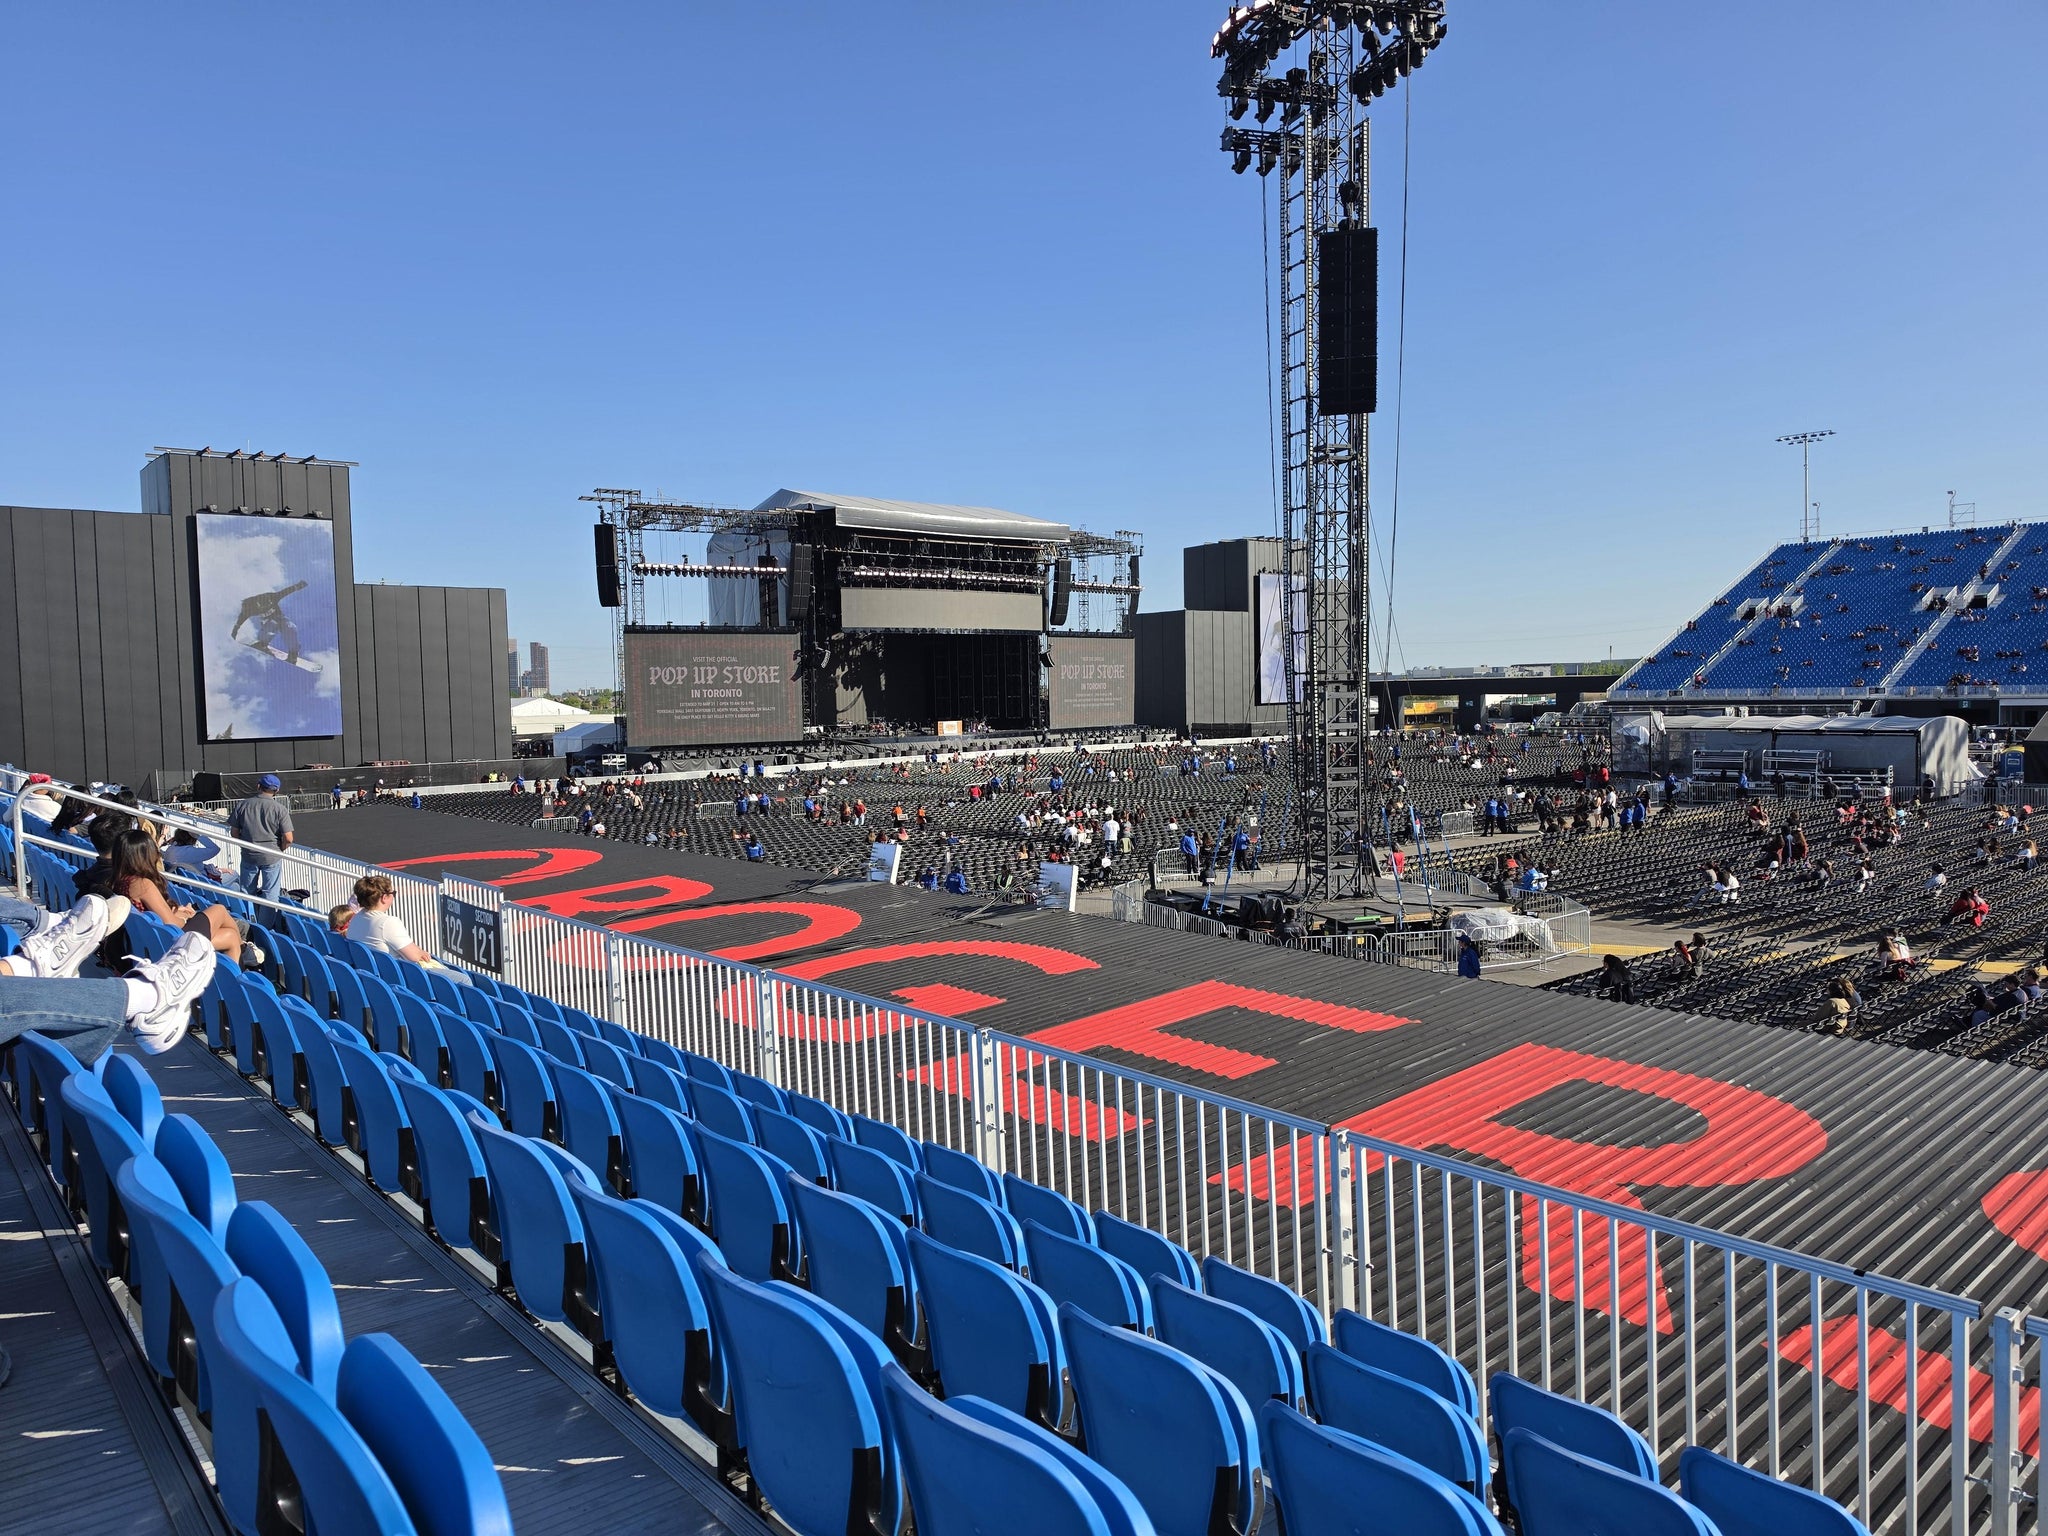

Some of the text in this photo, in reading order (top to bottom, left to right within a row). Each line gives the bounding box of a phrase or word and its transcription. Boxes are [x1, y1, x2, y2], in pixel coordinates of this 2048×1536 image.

[649, 665, 780, 685] POP UP STORE
[1060, 664, 1125, 680] POP UP STORE
[691, 688, 743, 698] IN TORONTO
[544, 797, 552, 806] A1
[447, 899, 461, 914] SECTION
[475, 910, 494, 926] SECTION
[445, 914, 463, 955] 122
[472, 926, 495, 967] 121
[171, 969, 187, 990] N
